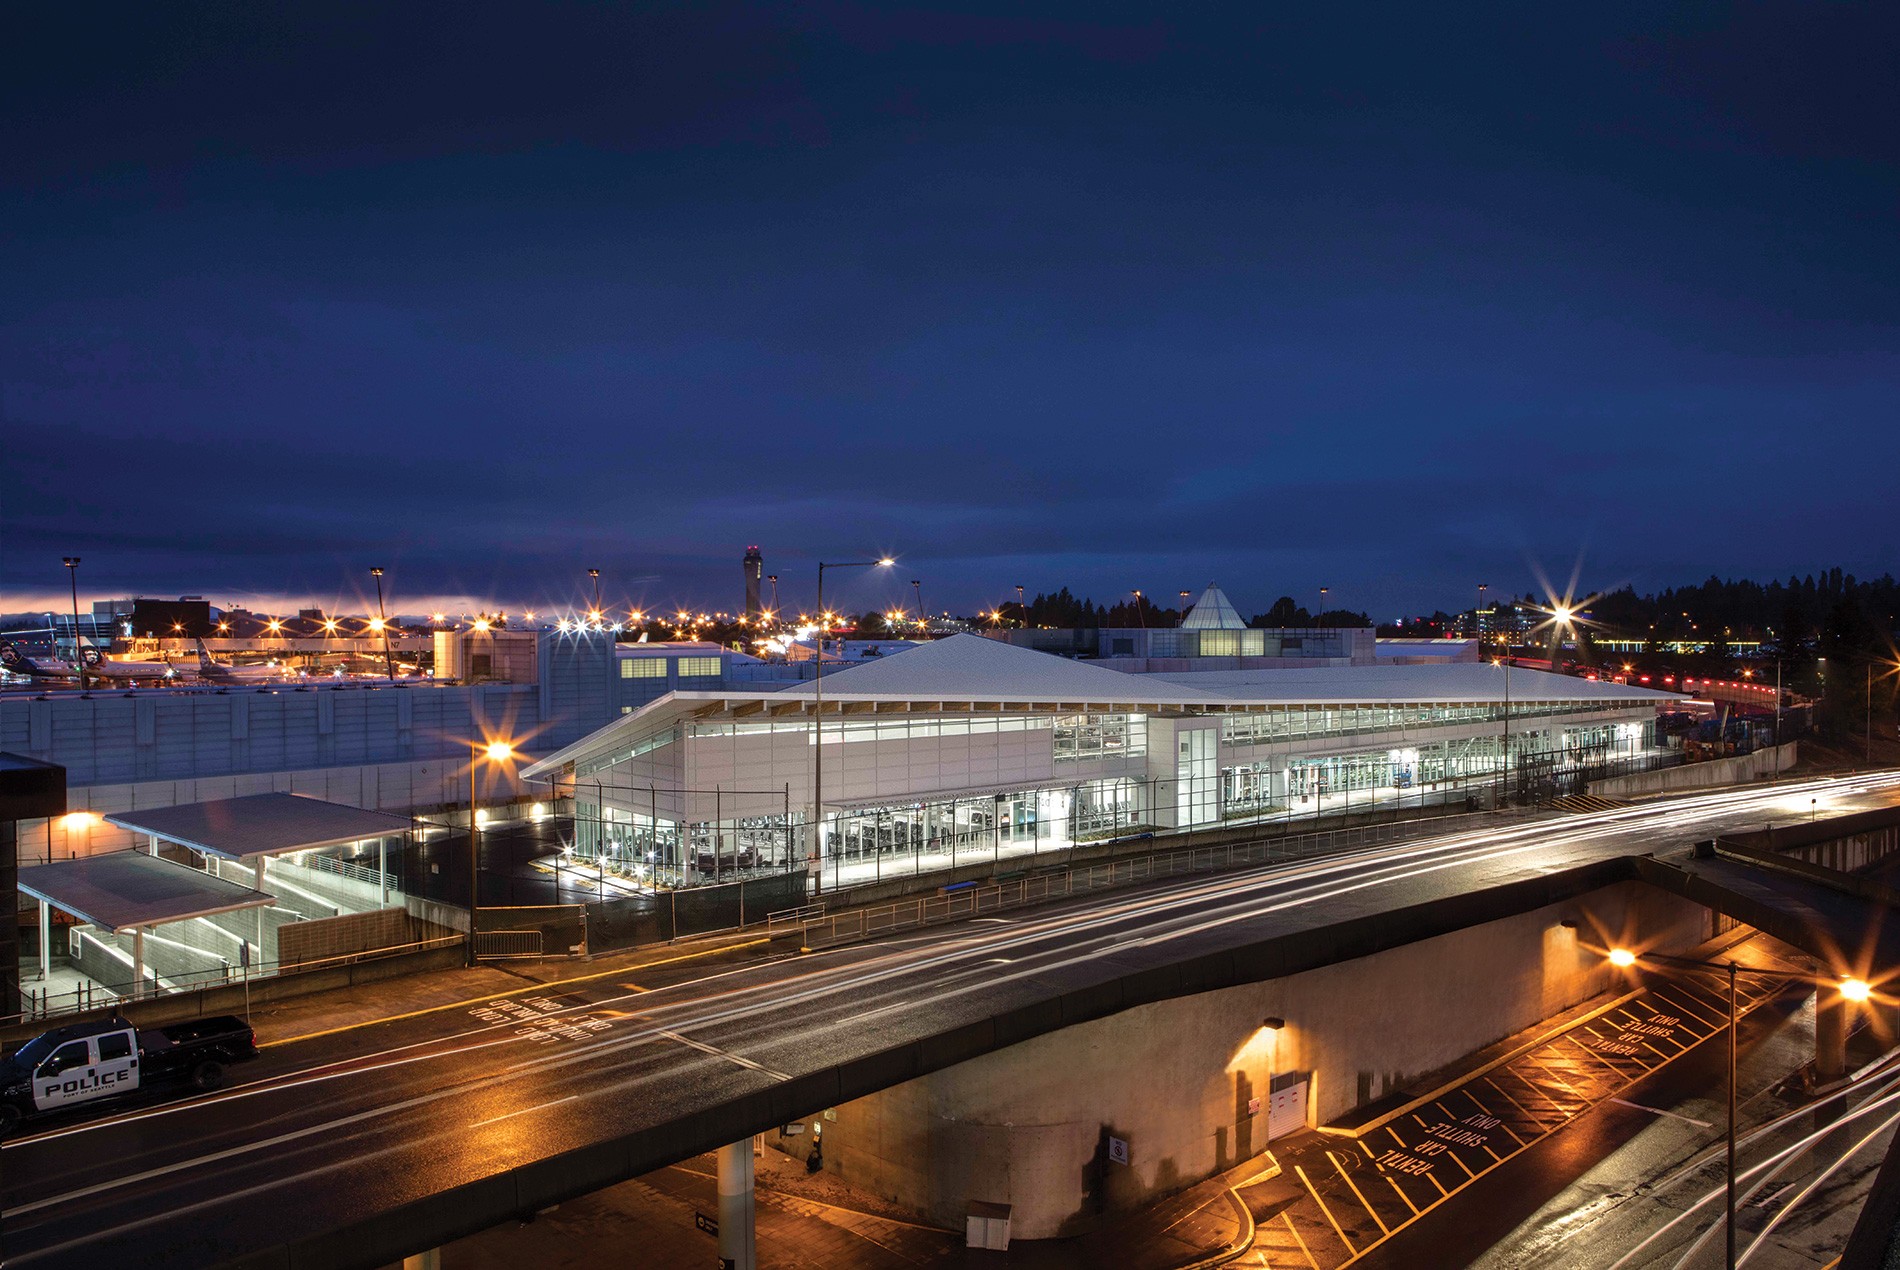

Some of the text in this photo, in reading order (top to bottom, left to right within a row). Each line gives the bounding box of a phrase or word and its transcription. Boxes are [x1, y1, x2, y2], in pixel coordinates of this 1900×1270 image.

[1647, 1014, 1681, 1026] ONLY
[1620, 1020, 1675, 1038] SHUTTLE
[1618, 1032, 1645, 1044] CAR
[1590, 1039, 1639, 1056] RENTAL
[45, 1069, 129, 1098] POLICE
[90, 1084, 115, 1093] SEATTLE
[1461, 1113, 1502, 1130] ONLY
[1424, 1122, 1488, 1148] SHUTTLE
[1414, 1139, 1448, 1157] CAR
[1375, 1149, 1435, 1176] RENTAL
